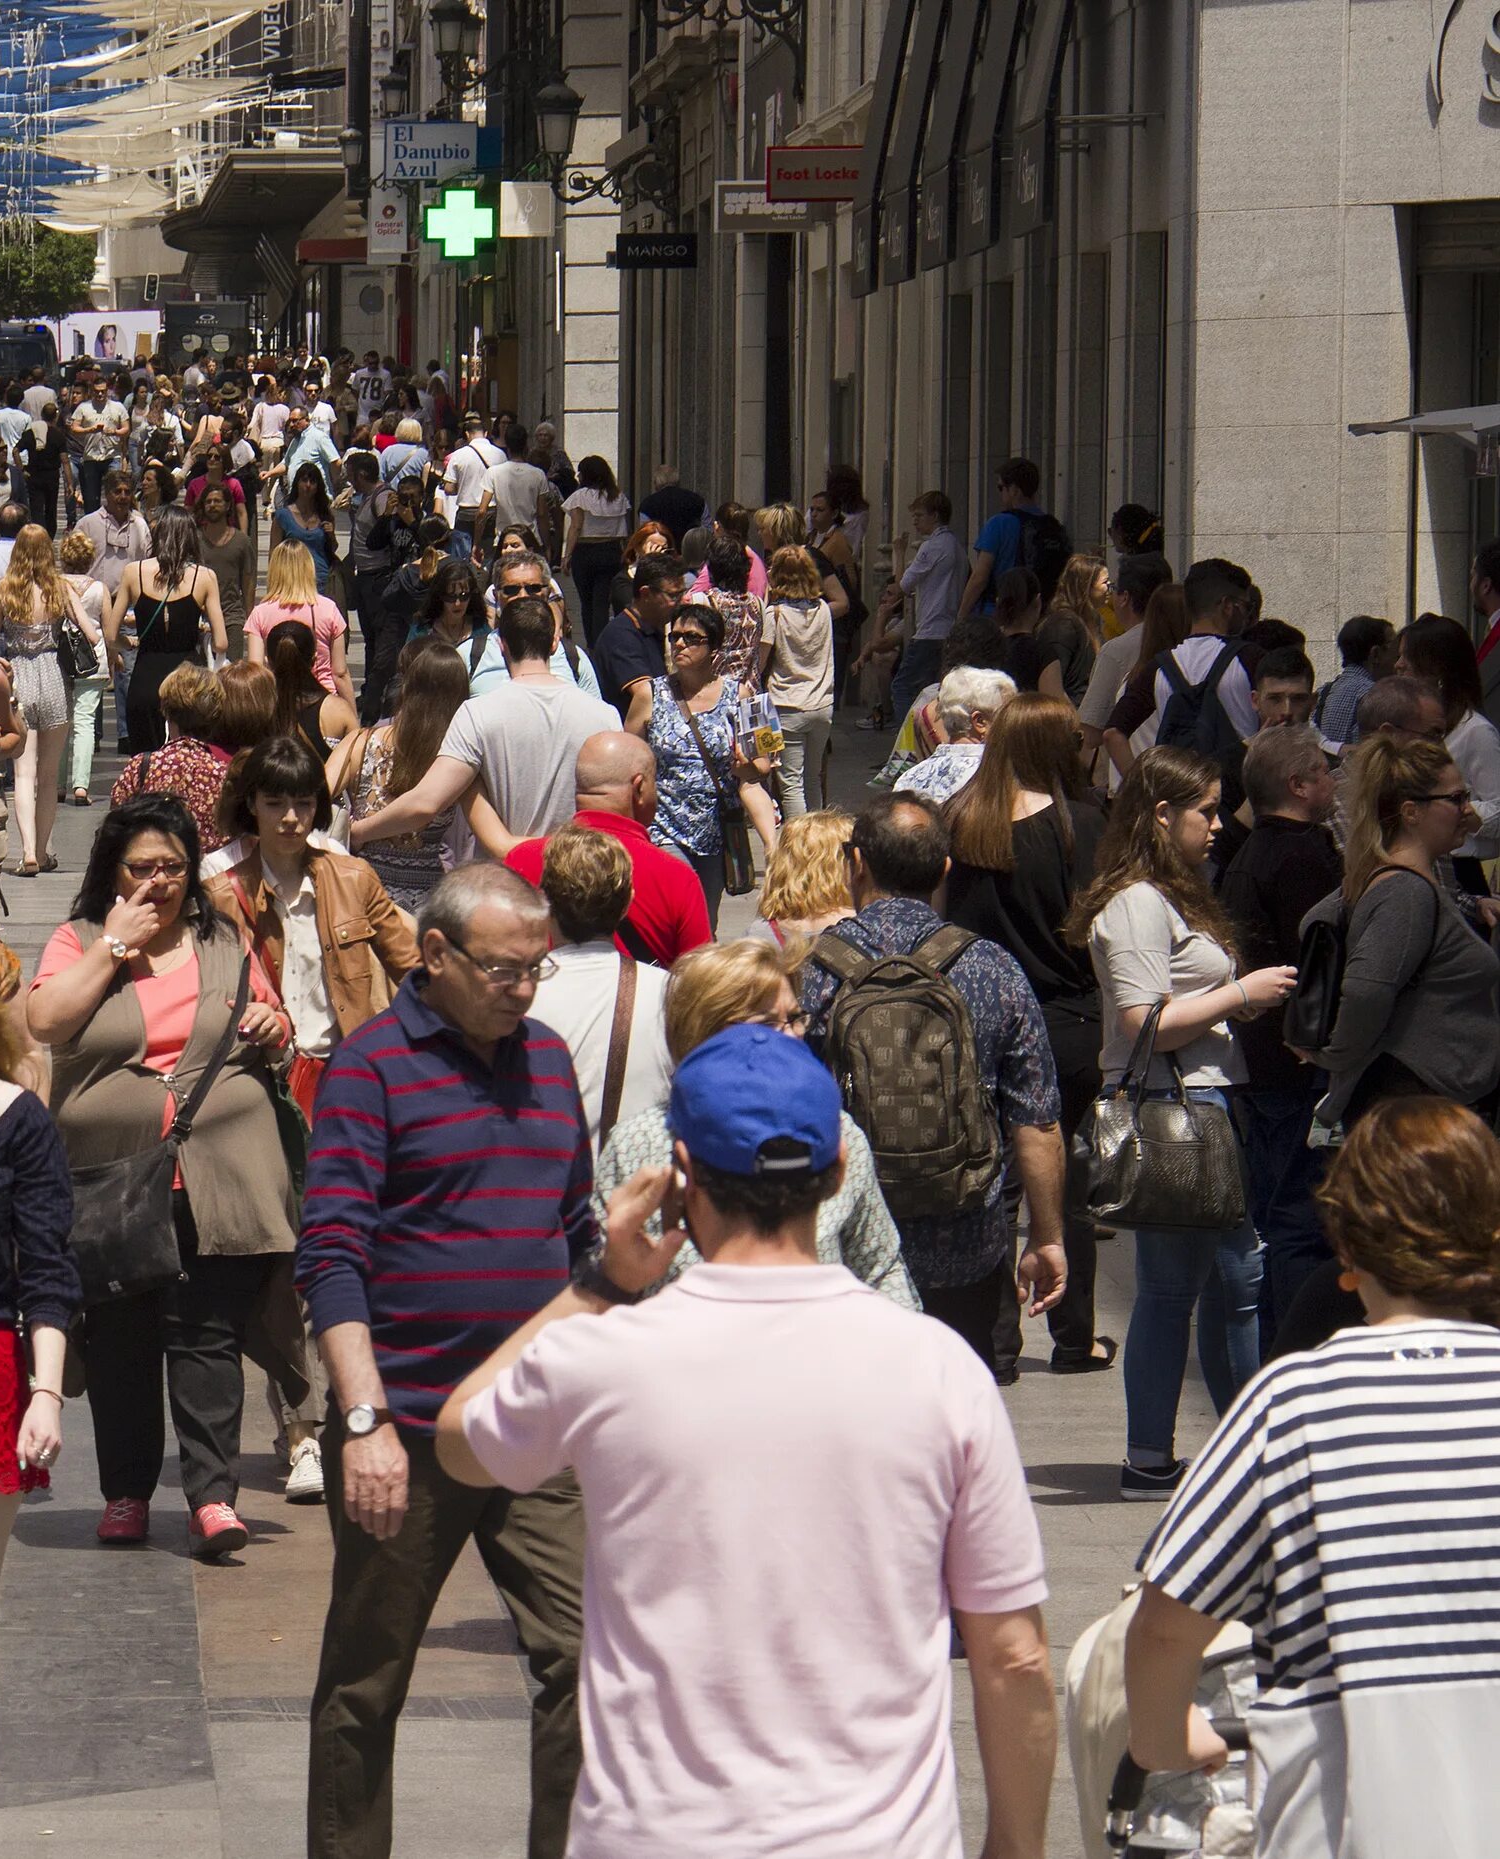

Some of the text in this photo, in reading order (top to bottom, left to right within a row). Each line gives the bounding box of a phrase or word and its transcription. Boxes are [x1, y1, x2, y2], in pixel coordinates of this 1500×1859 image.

[393, 126, 413, 142] El
[393, 143, 470, 160] Danubio
[393, 161, 437, 177] Azul
[776, 166, 860, 181] Foot Locke
[374, 220, 404, 228] General
[627, 245, 688, 257] MANGO
[359, 376, 383, 401] 78
